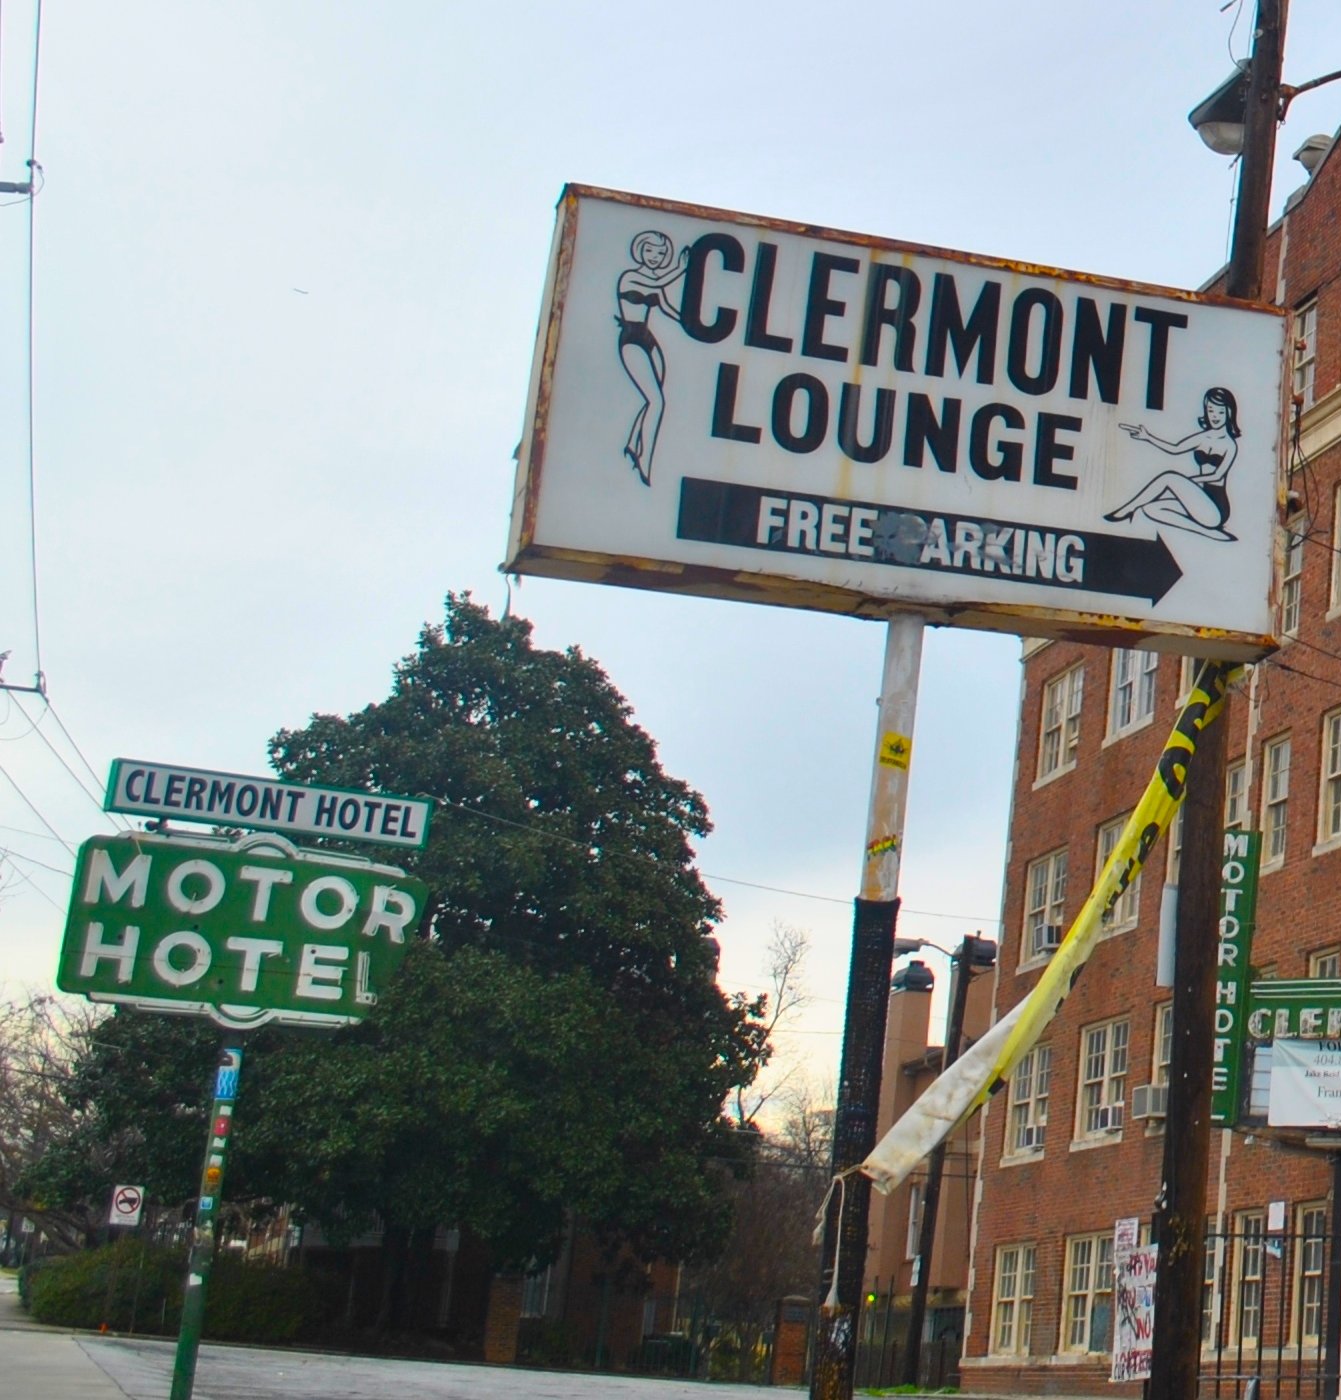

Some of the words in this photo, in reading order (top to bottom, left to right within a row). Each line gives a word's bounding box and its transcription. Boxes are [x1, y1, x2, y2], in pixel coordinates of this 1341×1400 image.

[679, 233, 1187, 410] CLERMONT
[710, 363, 1082, 489] LOUNGE
[757, 496, 879, 556] FREE
[125, 769, 305, 823] CLERMONT
[314, 795, 416, 838] HOTEL
[84, 849, 416, 944] MOTOR
[1218, 833, 1248, 967] MOTOR
[80, 922, 377, 1005] HOTEL
[1210, 981, 1236, 1120] HOTEL
